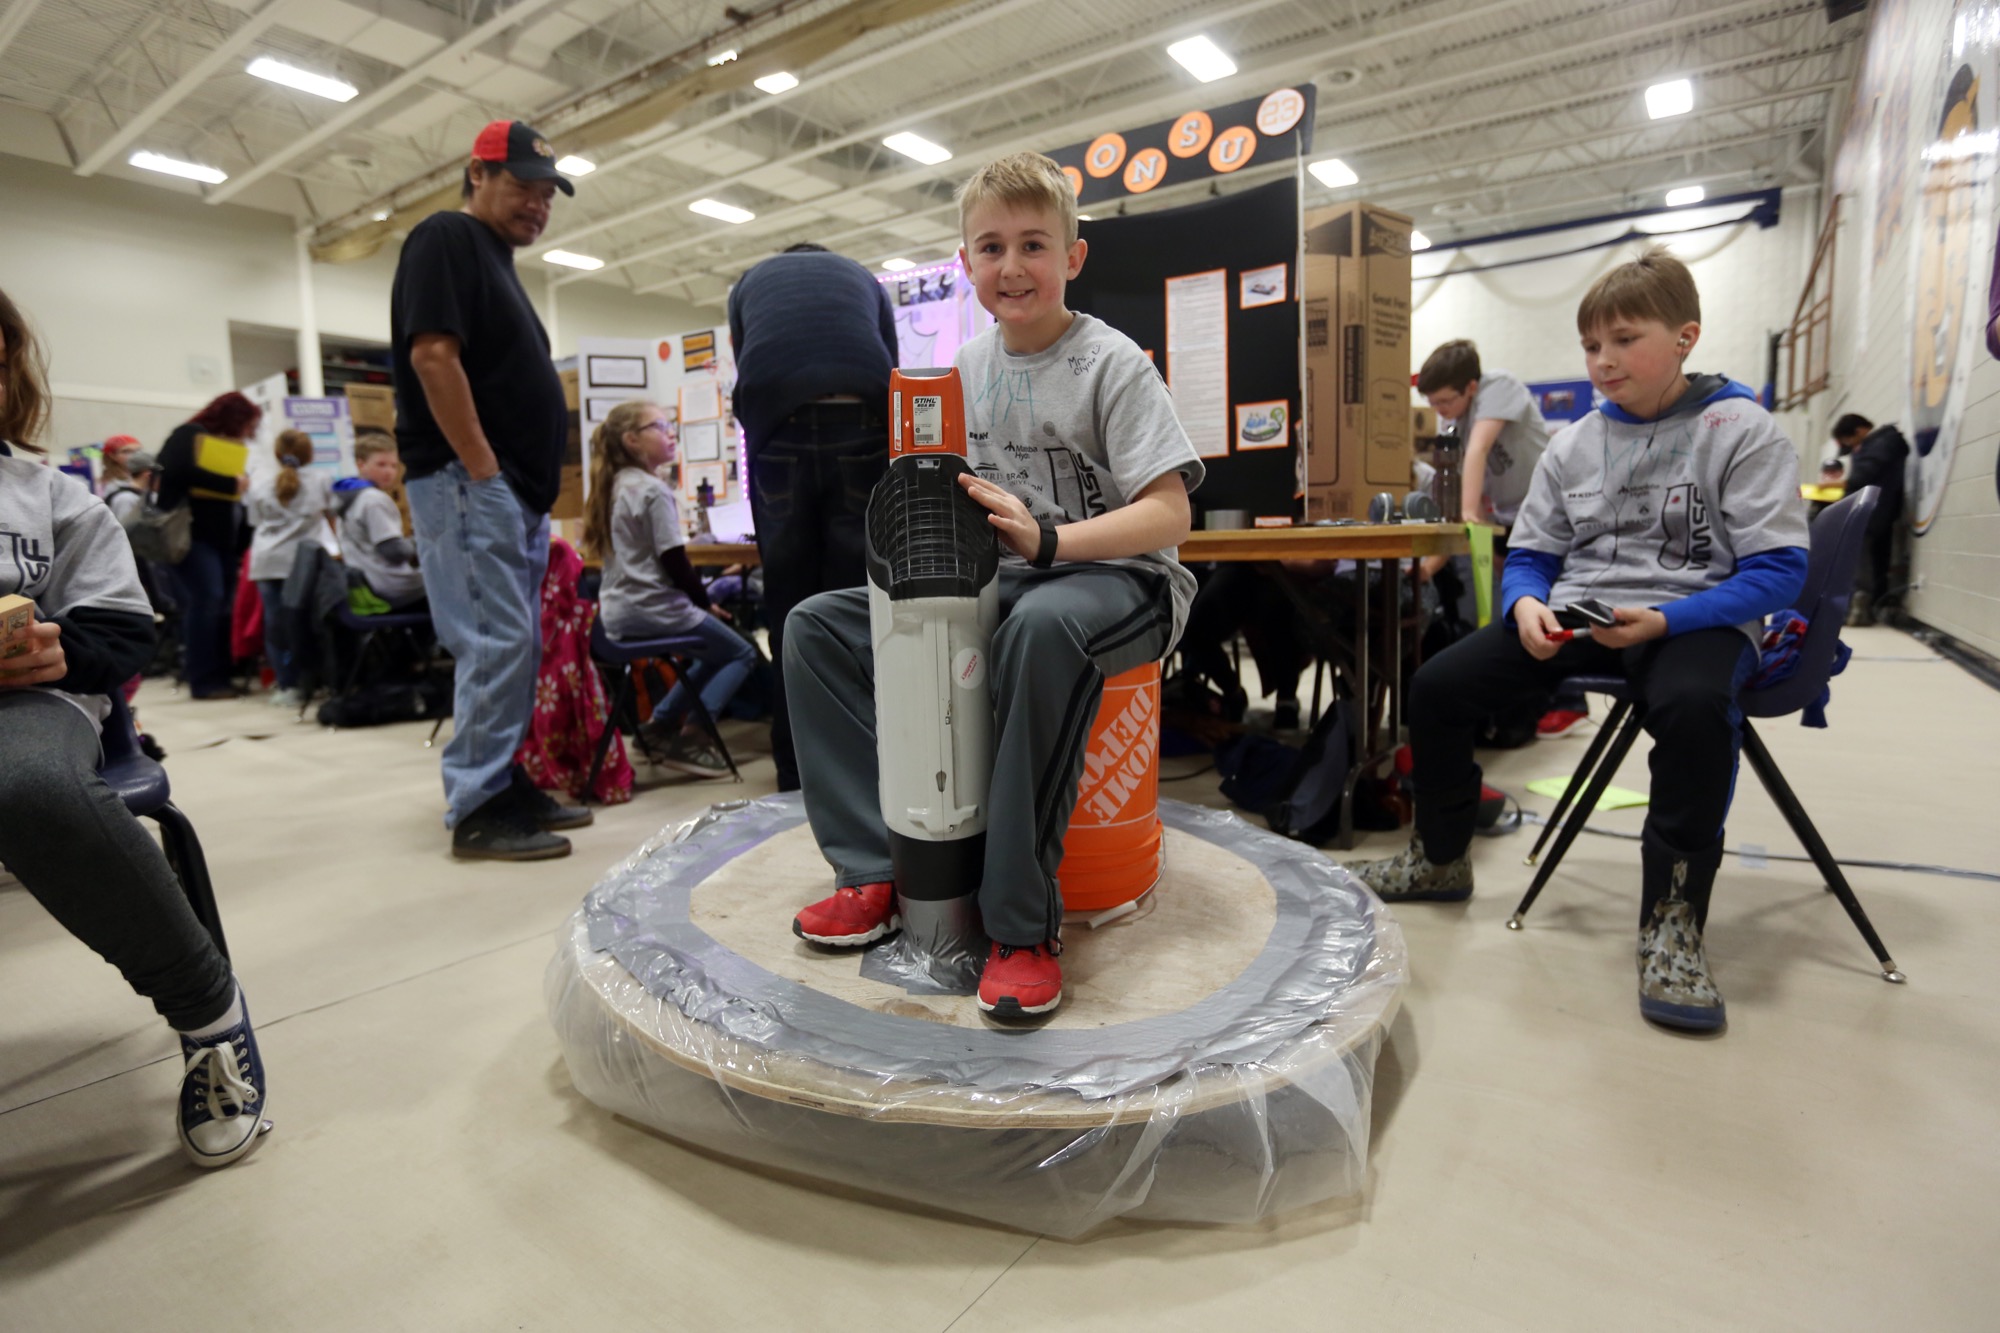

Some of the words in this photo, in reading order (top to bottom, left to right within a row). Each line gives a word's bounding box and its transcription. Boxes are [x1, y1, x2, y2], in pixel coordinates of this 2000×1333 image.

[1067, 118, 1248, 187] ONSU
[1261, 96, 1299, 128] 23
[1083, 712, 1160, 827] HOME
